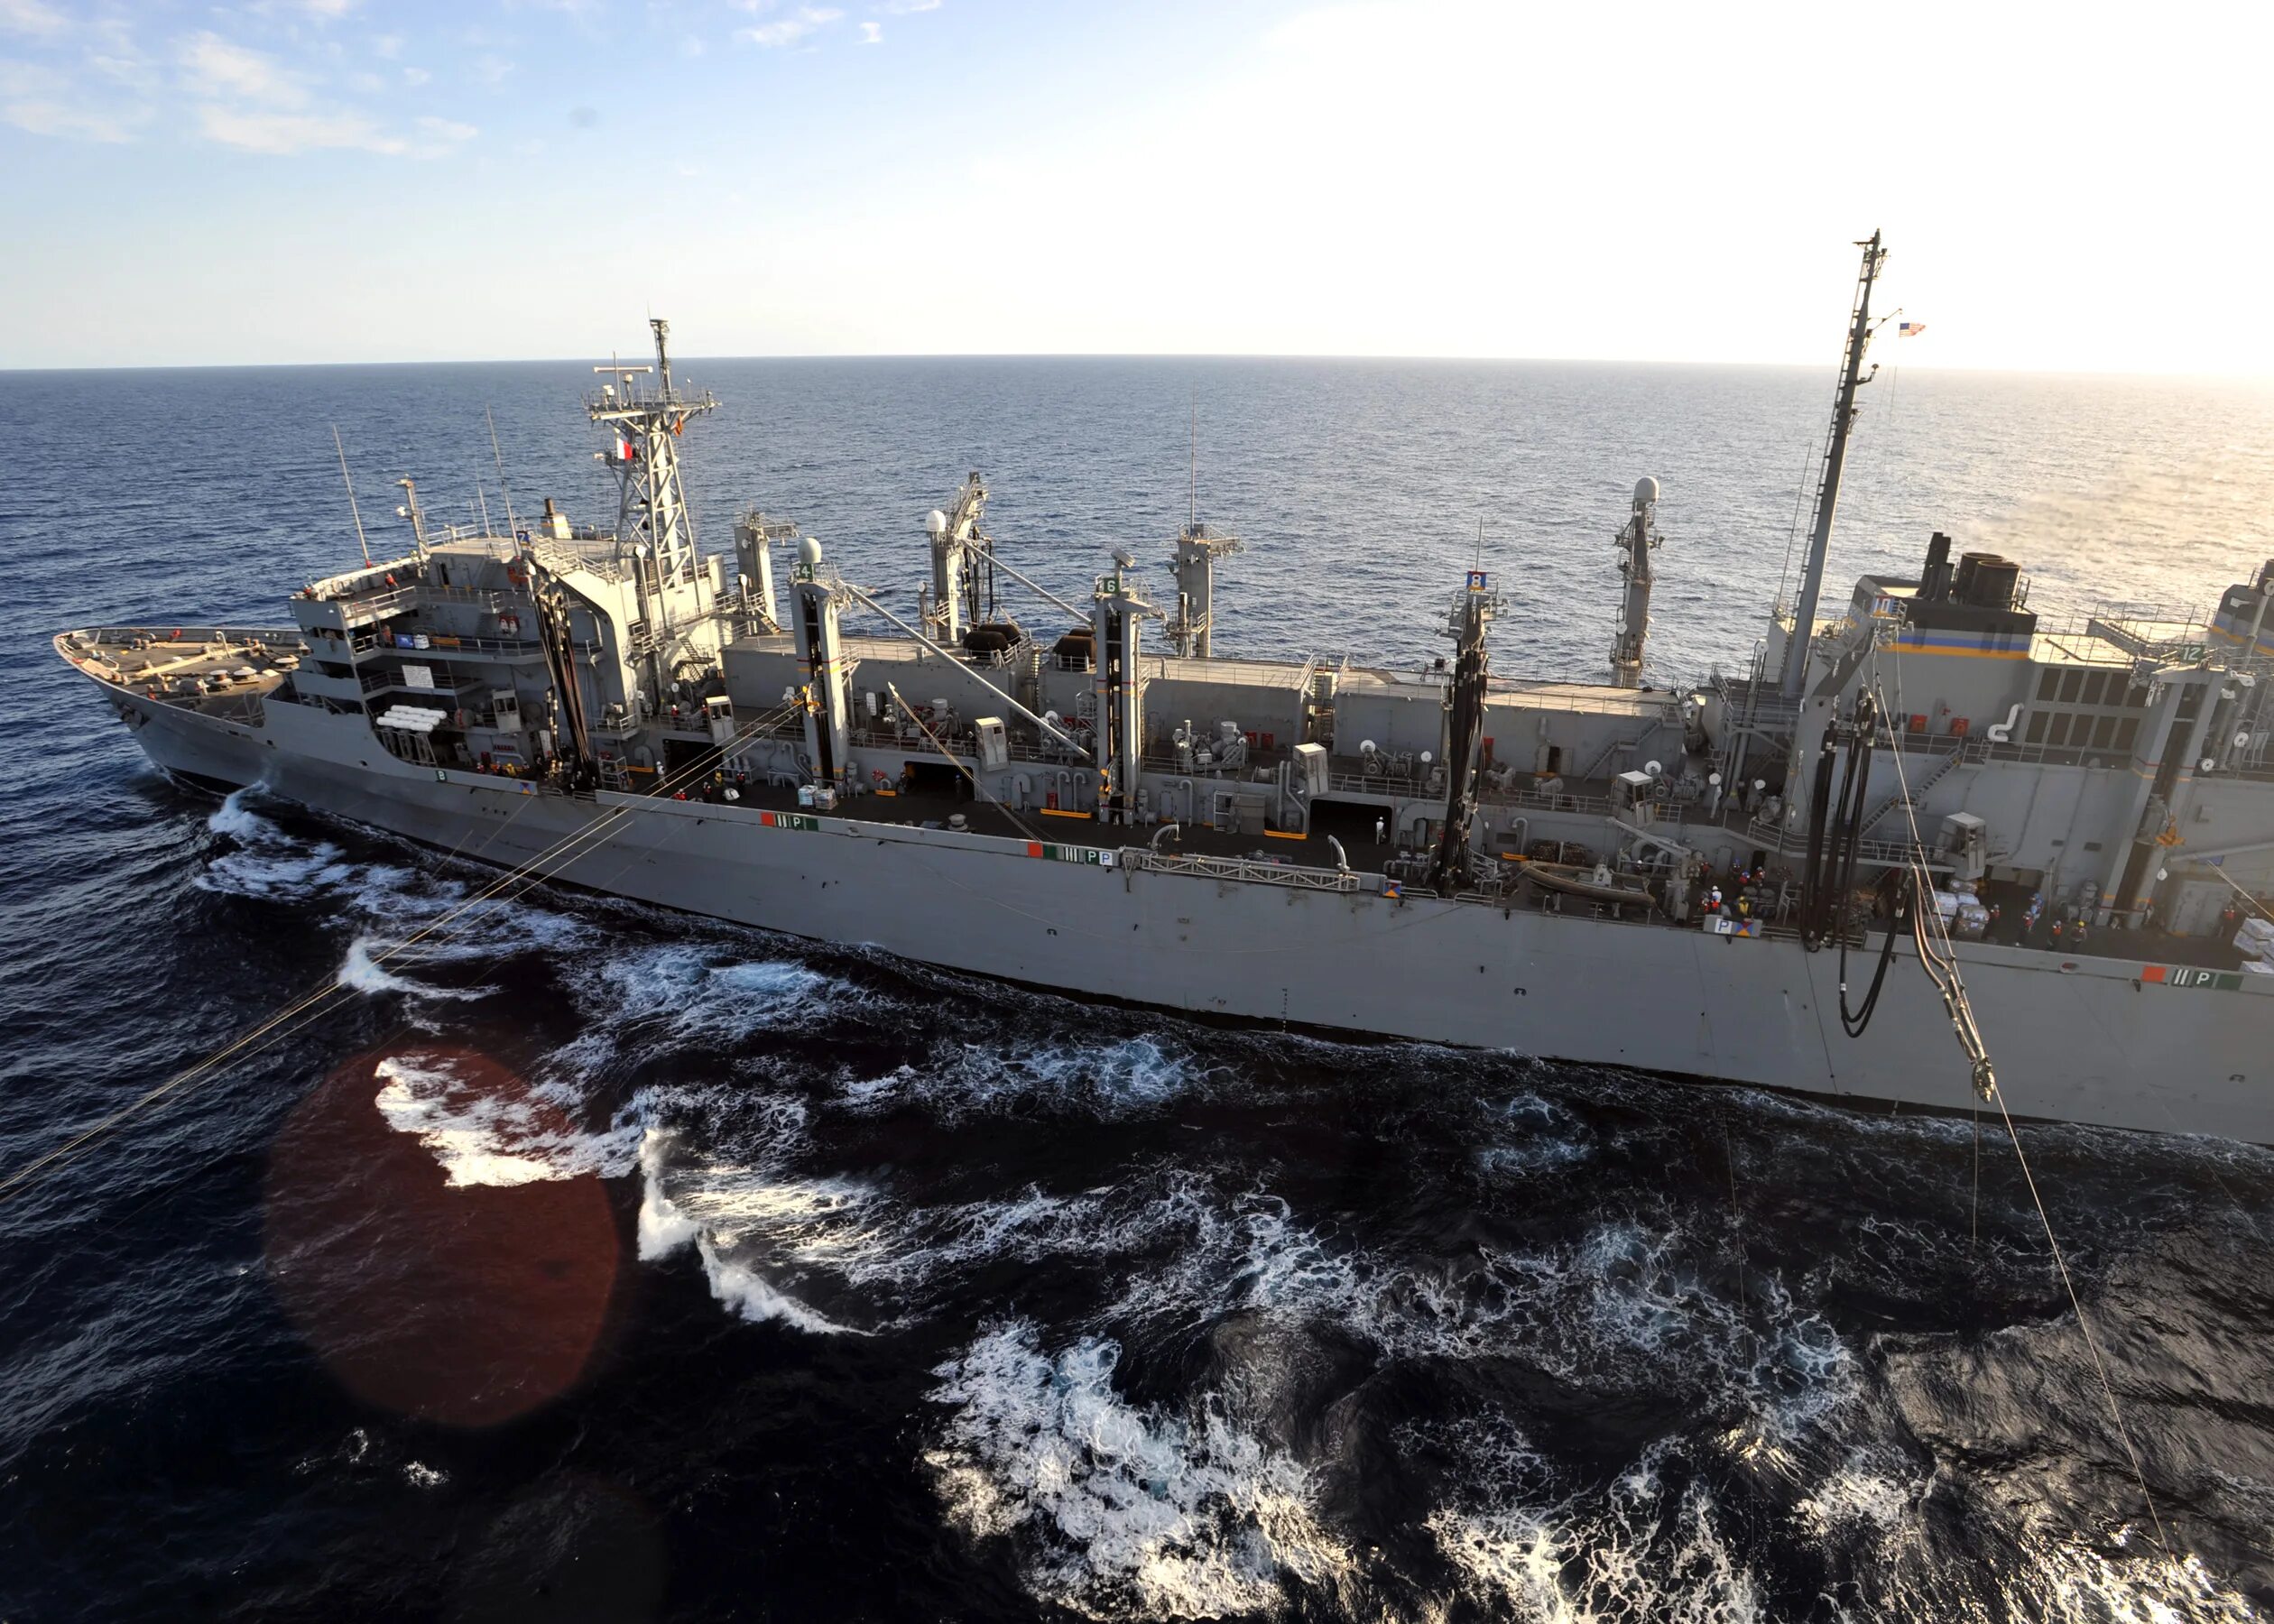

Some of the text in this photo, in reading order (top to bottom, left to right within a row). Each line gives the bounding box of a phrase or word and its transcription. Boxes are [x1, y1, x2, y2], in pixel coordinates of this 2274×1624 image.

[801, 566, 810, 577] 4
[1107, 580, 1115, 592] 6
[1472, 574, 1481, 587] 8
[2184, 647, 2201, 660] 12
[793, 817, 800, 827] P
[1088, 851, 1110, 863] P P
[1718, 920, 1729, 931] P
[2196, 973, 2210, 984] P
